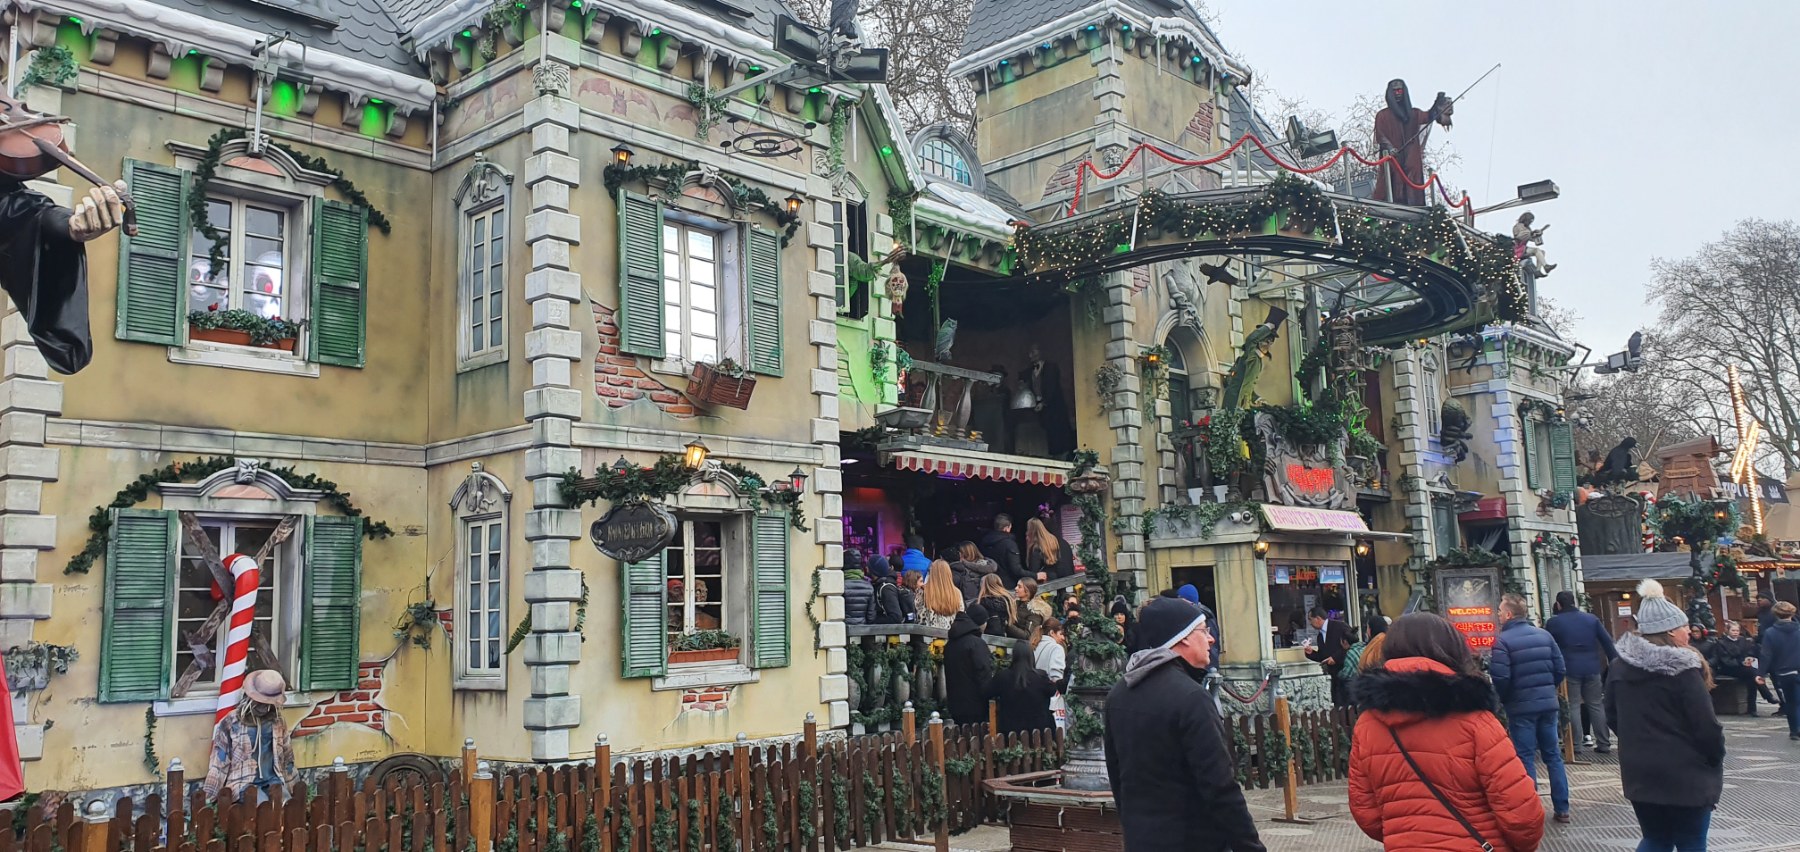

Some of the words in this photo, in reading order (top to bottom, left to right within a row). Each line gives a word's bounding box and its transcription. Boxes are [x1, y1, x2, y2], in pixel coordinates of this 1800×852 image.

[1742, 483, 1765, 499] BR
[1268, 507, 1319, 528] HAUNTED
[1318, 512, 1364, 529] MANSION
[1448, 607, 1491, 615] WELCOME
